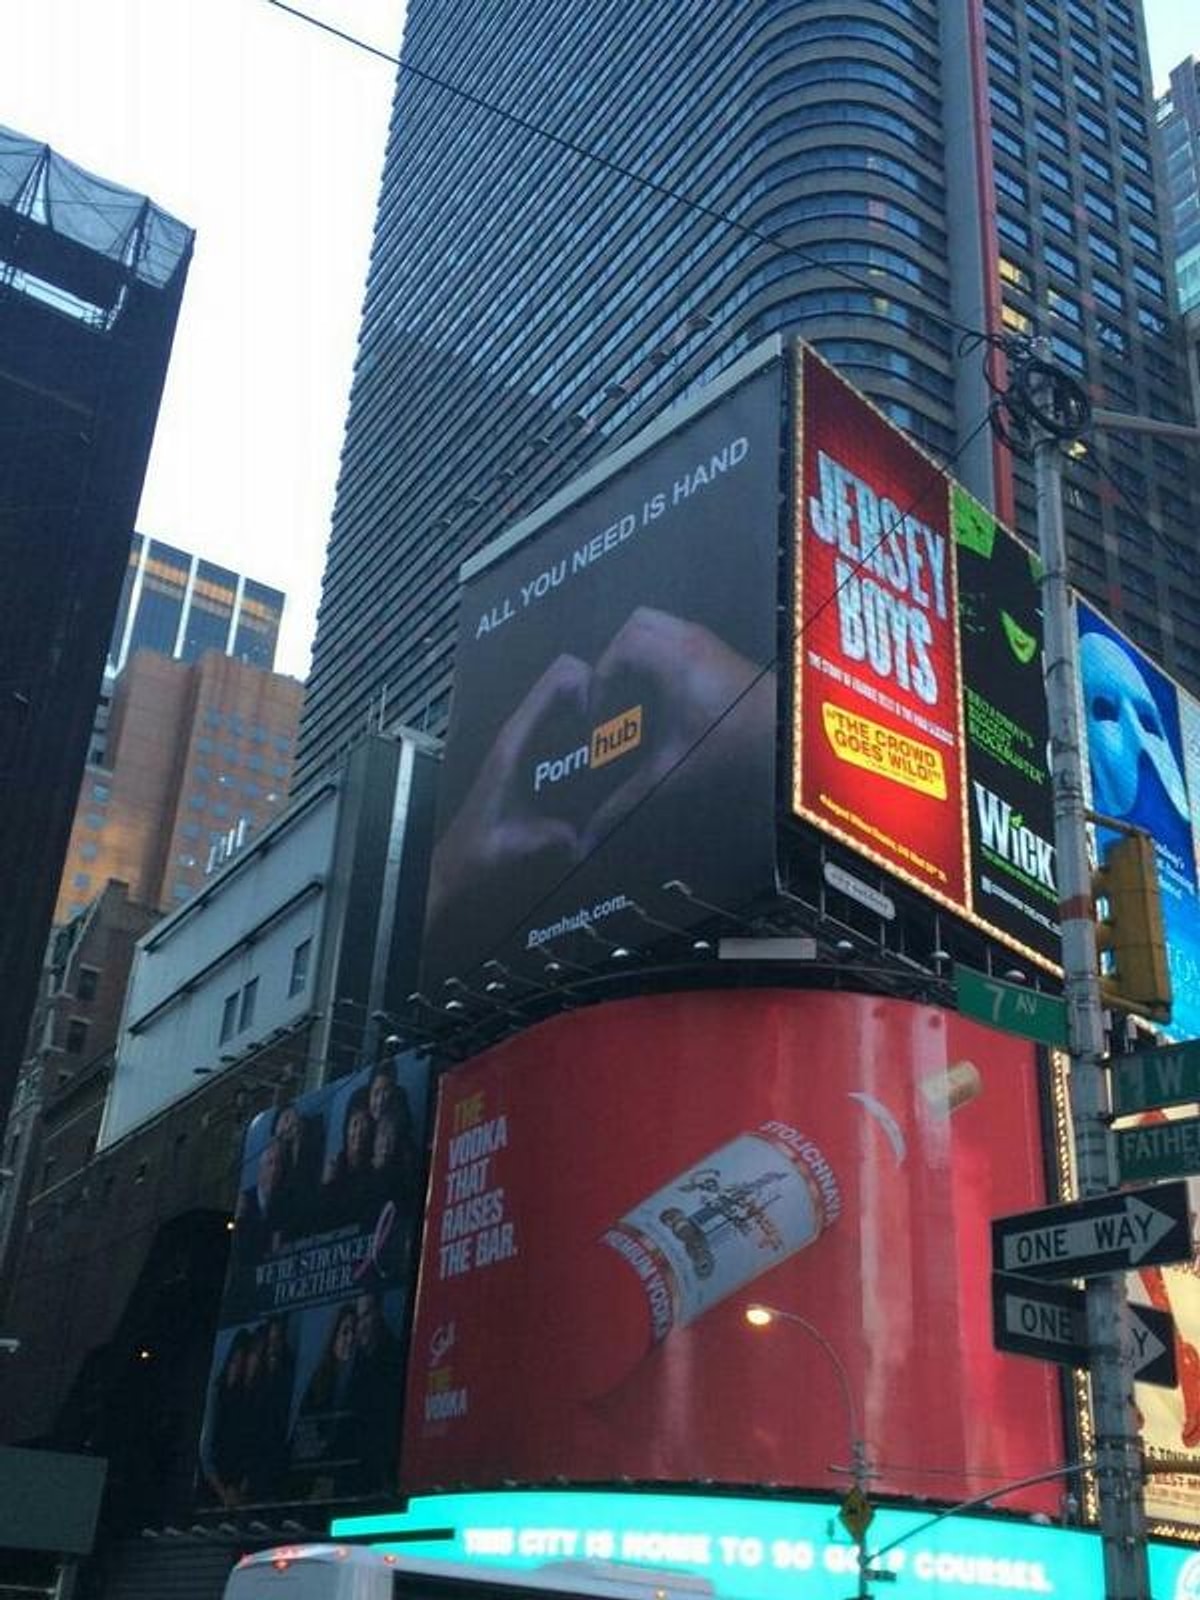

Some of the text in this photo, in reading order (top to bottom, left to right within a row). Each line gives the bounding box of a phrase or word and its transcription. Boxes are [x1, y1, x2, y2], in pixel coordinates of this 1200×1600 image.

[475, 437, 749, 641] ALL YOU NEED IS HAND
[809, 450, 947, 621] JERSEY
[835, 557, 938, 706] BOYS
[834, 727, 884, 763] GOES
[875, 729, 936, 768] CROWD
[984, 982, 1037, 1022] 7 AV
[448, 1115, 508, 1168] VODKA
[1122, 1123, 1200, 1161] FATHE
[446, 1157, 490, 1204] THAT
[441, 1188, 504, 1240] RAISES
[439, 1237, 471, 1281] THE
[1016, 1211, 1155, 1265] ONE WAY
[1020, 1303, 1074, 1342] ONE
[518, 1529, 578, 1557] CITY
[622, 1534, 711, 1565] HOME
[720, 1536, 764, 1567] TO
[824, 1545, 904, 1573] GOF
